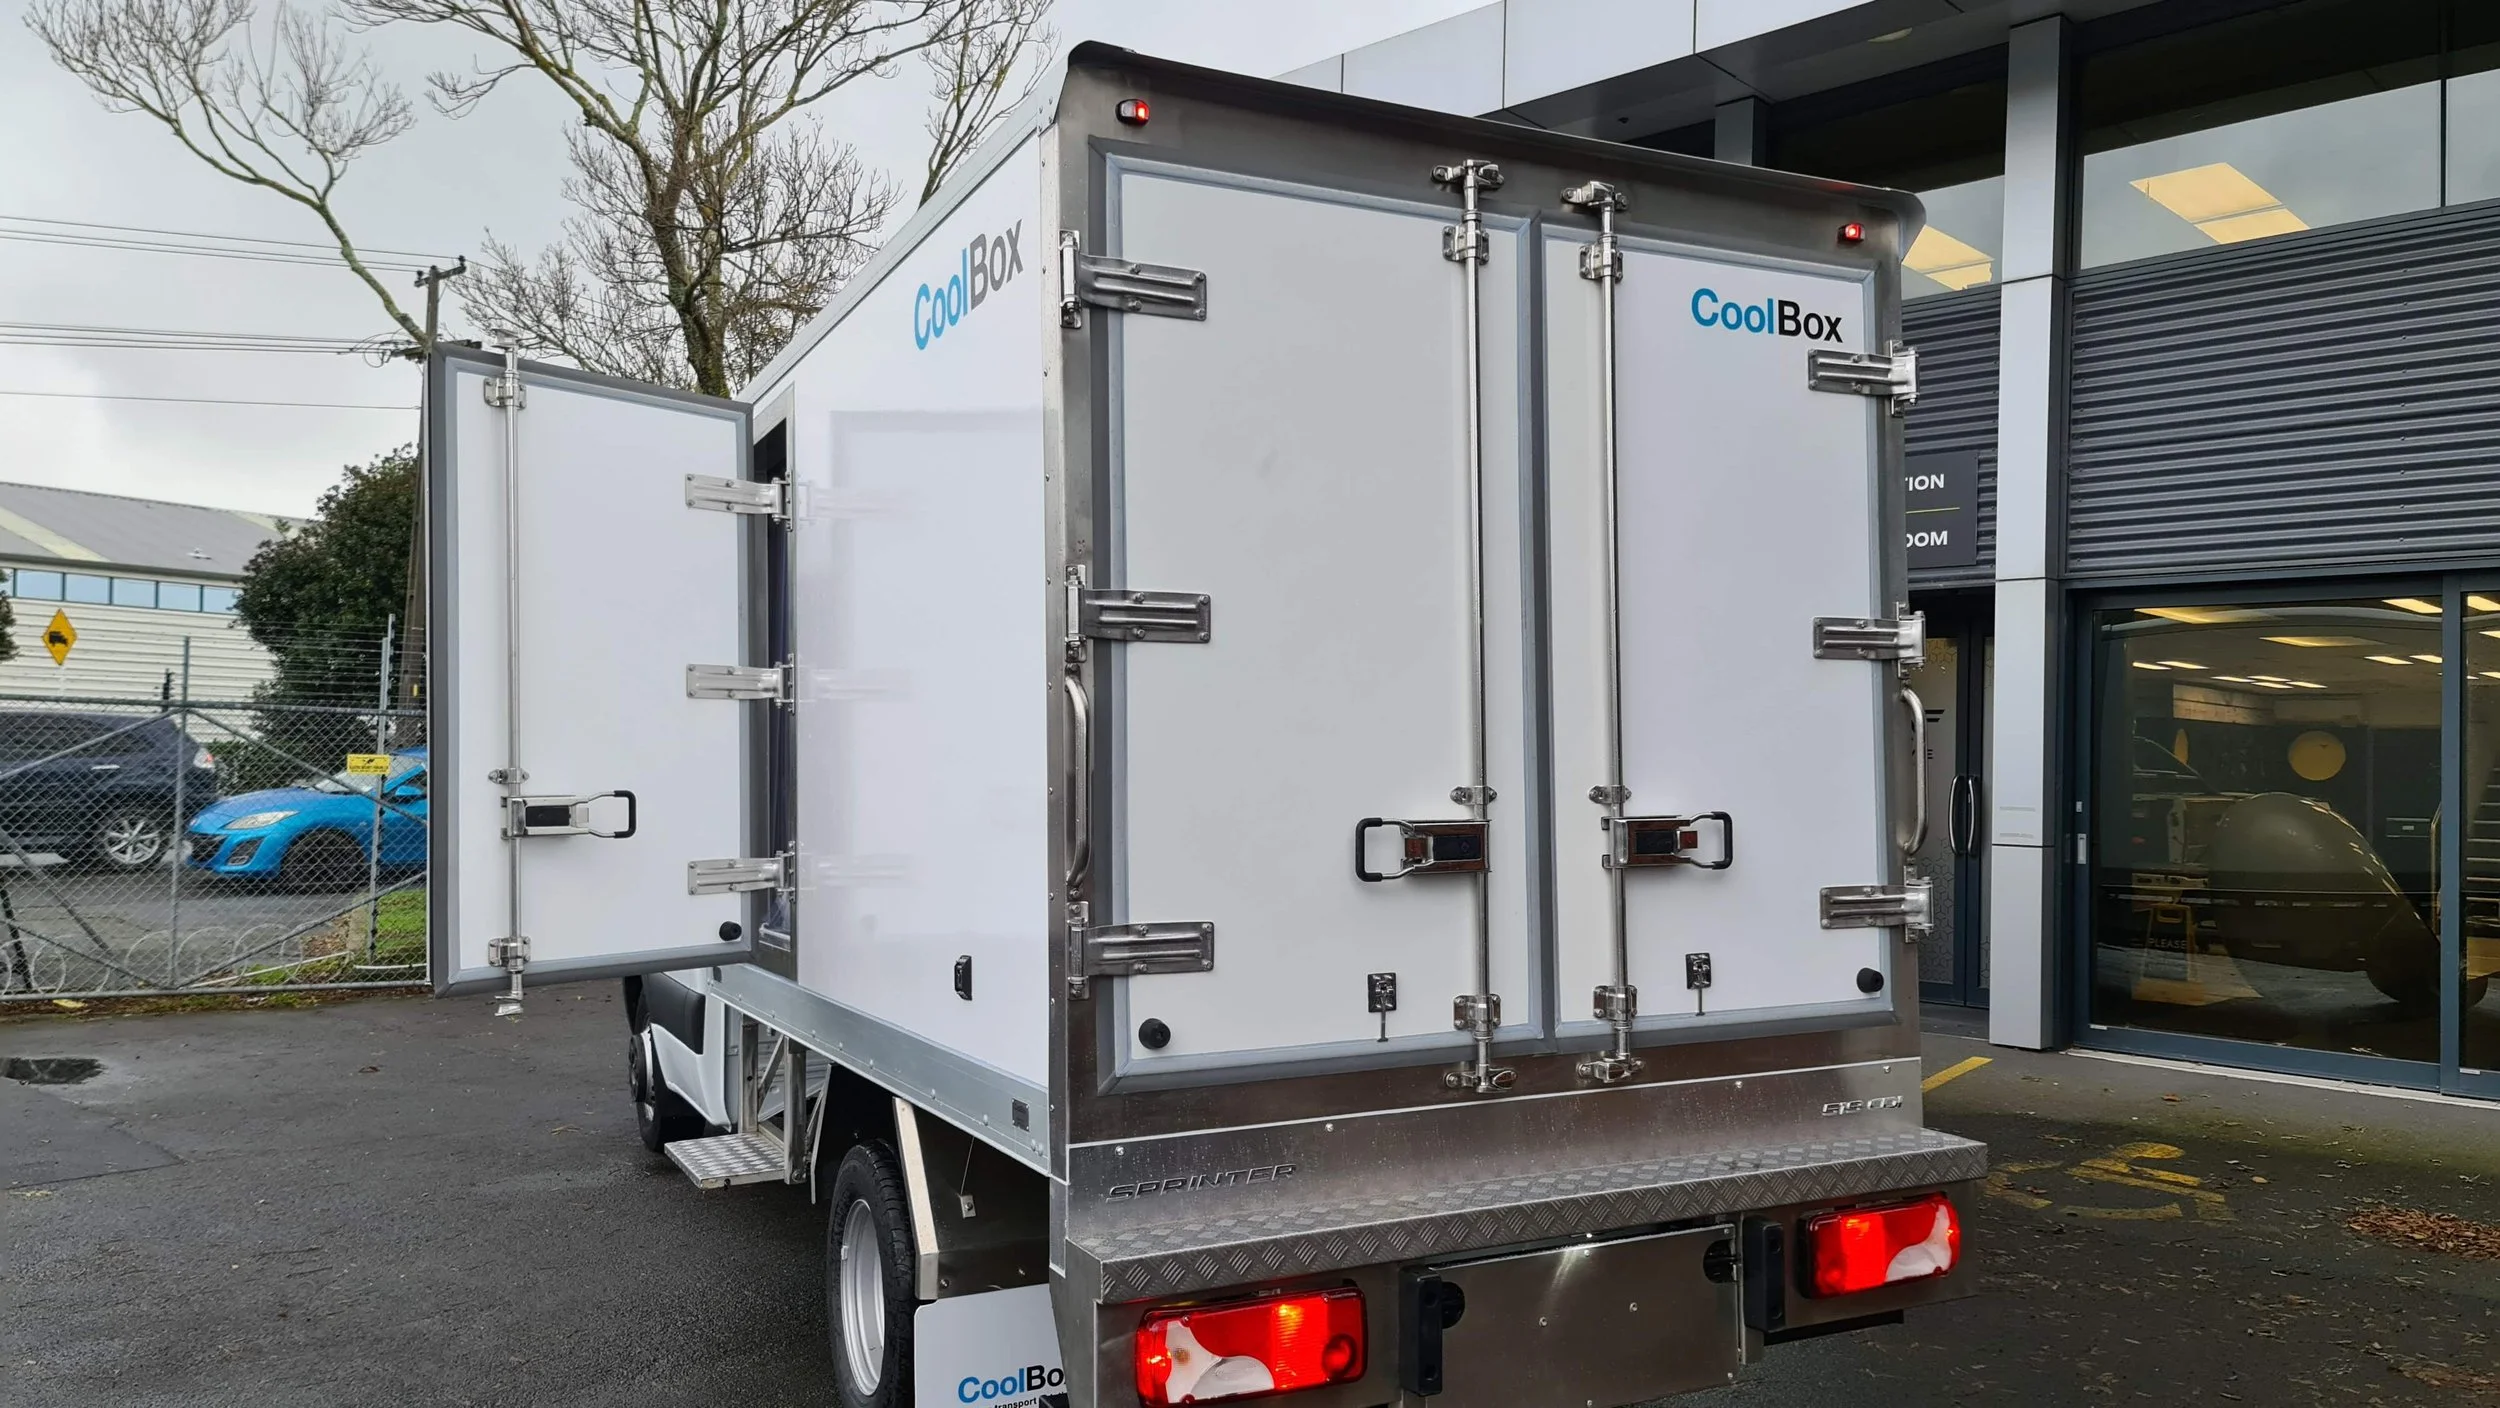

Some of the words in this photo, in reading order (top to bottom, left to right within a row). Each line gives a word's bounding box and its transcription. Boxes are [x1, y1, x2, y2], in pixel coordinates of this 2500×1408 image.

[914, 218, 1024, 350] CoolBox
[1691, 288, 1843, 343] CoolBox
[1905, 473, 1945, 491] ION
[1105, 1163, 1297, 1203] SPRINTER
[958, 1365, 1066, 1403] CoolBo
